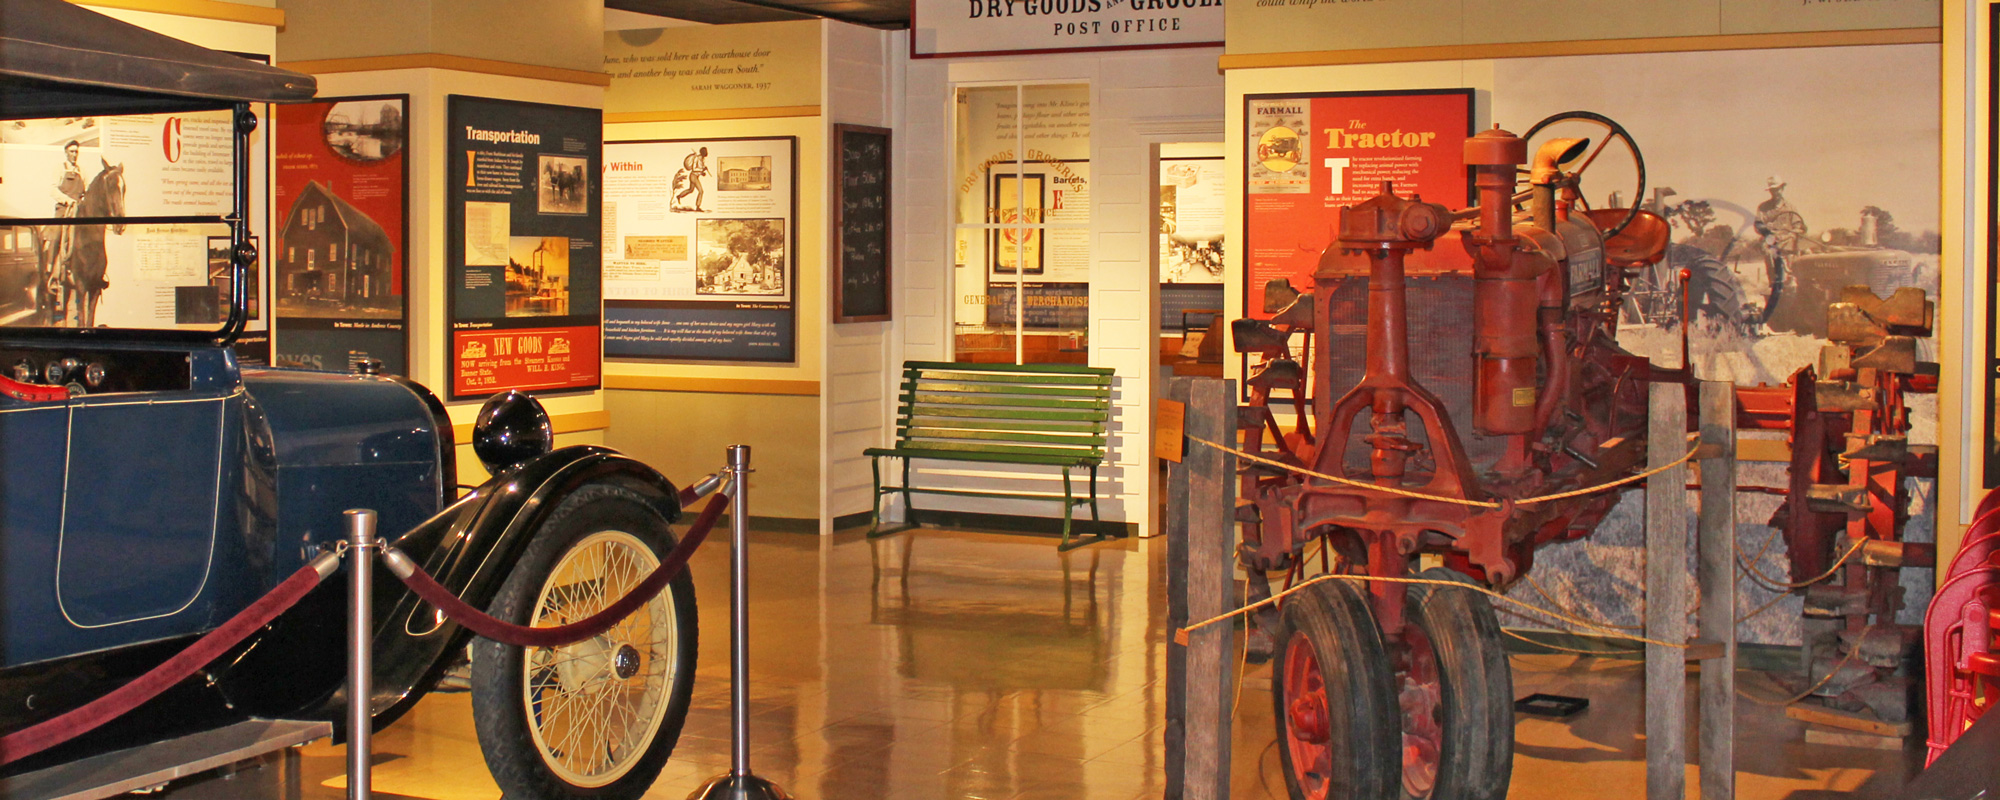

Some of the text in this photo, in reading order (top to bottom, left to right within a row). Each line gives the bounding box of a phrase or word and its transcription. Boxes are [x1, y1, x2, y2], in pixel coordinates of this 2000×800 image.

[969, 0, 1015, 18] DRY
[1024, 0, 1101, 16] GOODS
[1054, 18, 1181, 35] POST OFFICE
[622, 54, 639, 63] who
[641, 55, 655, 63] was
[656, 52, 672, 61] sold
[673, 51, 689, 61] here
[701, 51, 709, 60] de
[711, 49, 751, 60] courthouse
[753, 48, 771, 57] door
[617, 68, 632, 78] and
[633, 66, 662, 78] another
[663, 68, 677, 79] boy
[679, 69, 693, 77] was
[695, 65, 710, 76] sold
[712, 64, 734, 75] down
[735, 63, 764, 73] South."
[756, 82, 771, 90] 1937
[1257, 106, 1303, 115] FARMALL
[1349, 119, 1367, 129] The
[466, 125, 540, 145] Transportation
[1324, 128, 1436, 149] Tractor
[610, 161, 643, 172] Within
[960, 149, 1084, 194] DRY GOODS GROCERIES
[1324, 158, 1350, 194] T
[988, 207, 1057, 220] POST OFFICE
[964, 295, 1089, 306] GENERAL MERCHANDISE
[493, 336, 543, 356] NEW GOODS
[461, 360, 476, 368] NOW
[478, 360, 498, 369] arriving
[500, 358, 512, 367] from
[514, 357, 522, 365] the
